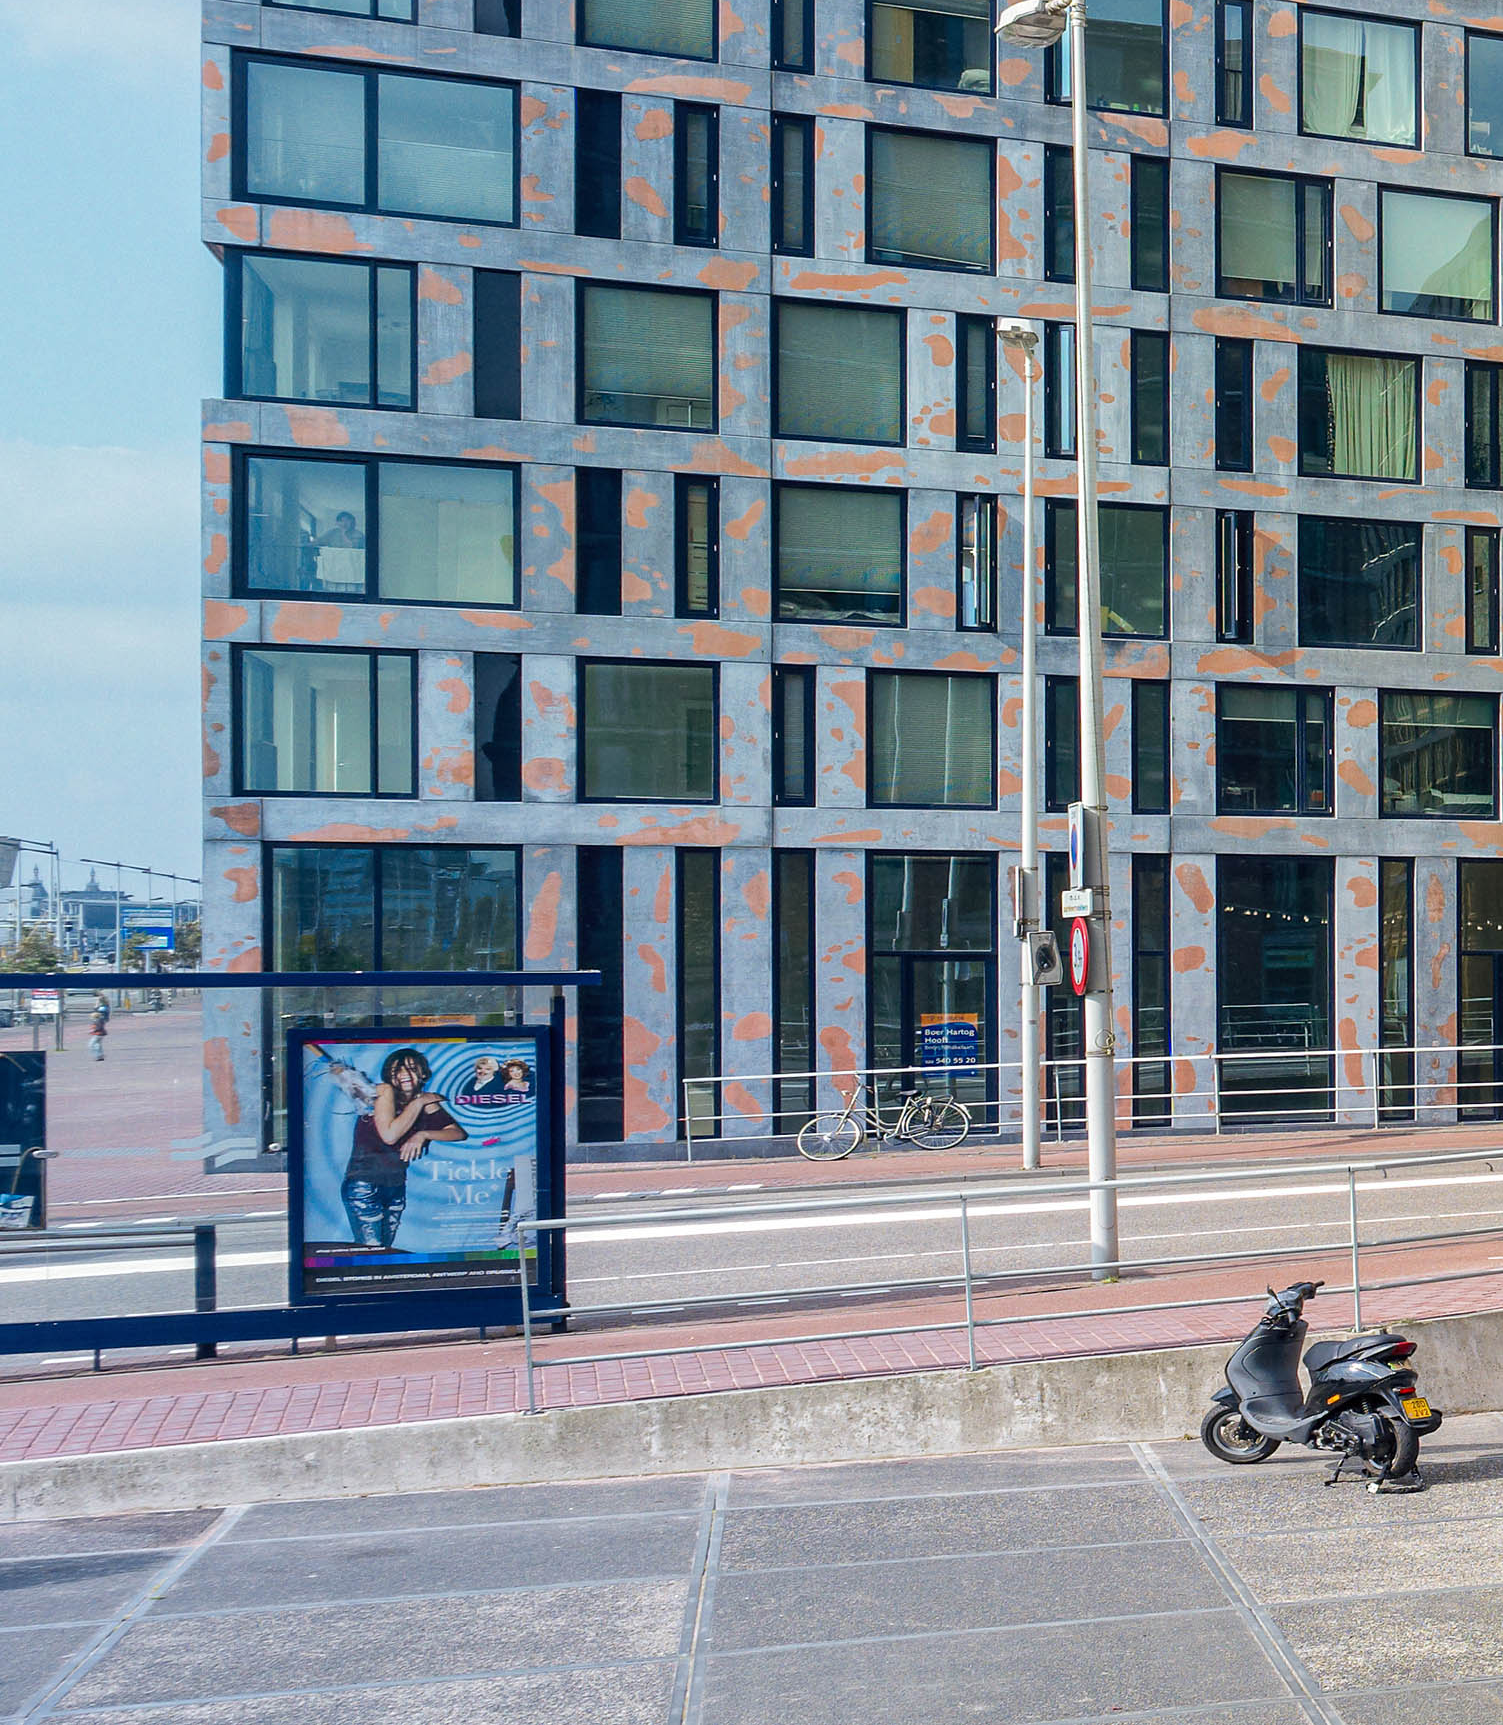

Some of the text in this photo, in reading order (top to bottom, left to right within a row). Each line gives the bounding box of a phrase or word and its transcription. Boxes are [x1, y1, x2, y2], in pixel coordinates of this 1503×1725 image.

[924, 1028, 975, 1037] Boer Hartog
[455, 1093, 533, 1106] DIESEL
[424, 1158, 513, 1182] Tickle
